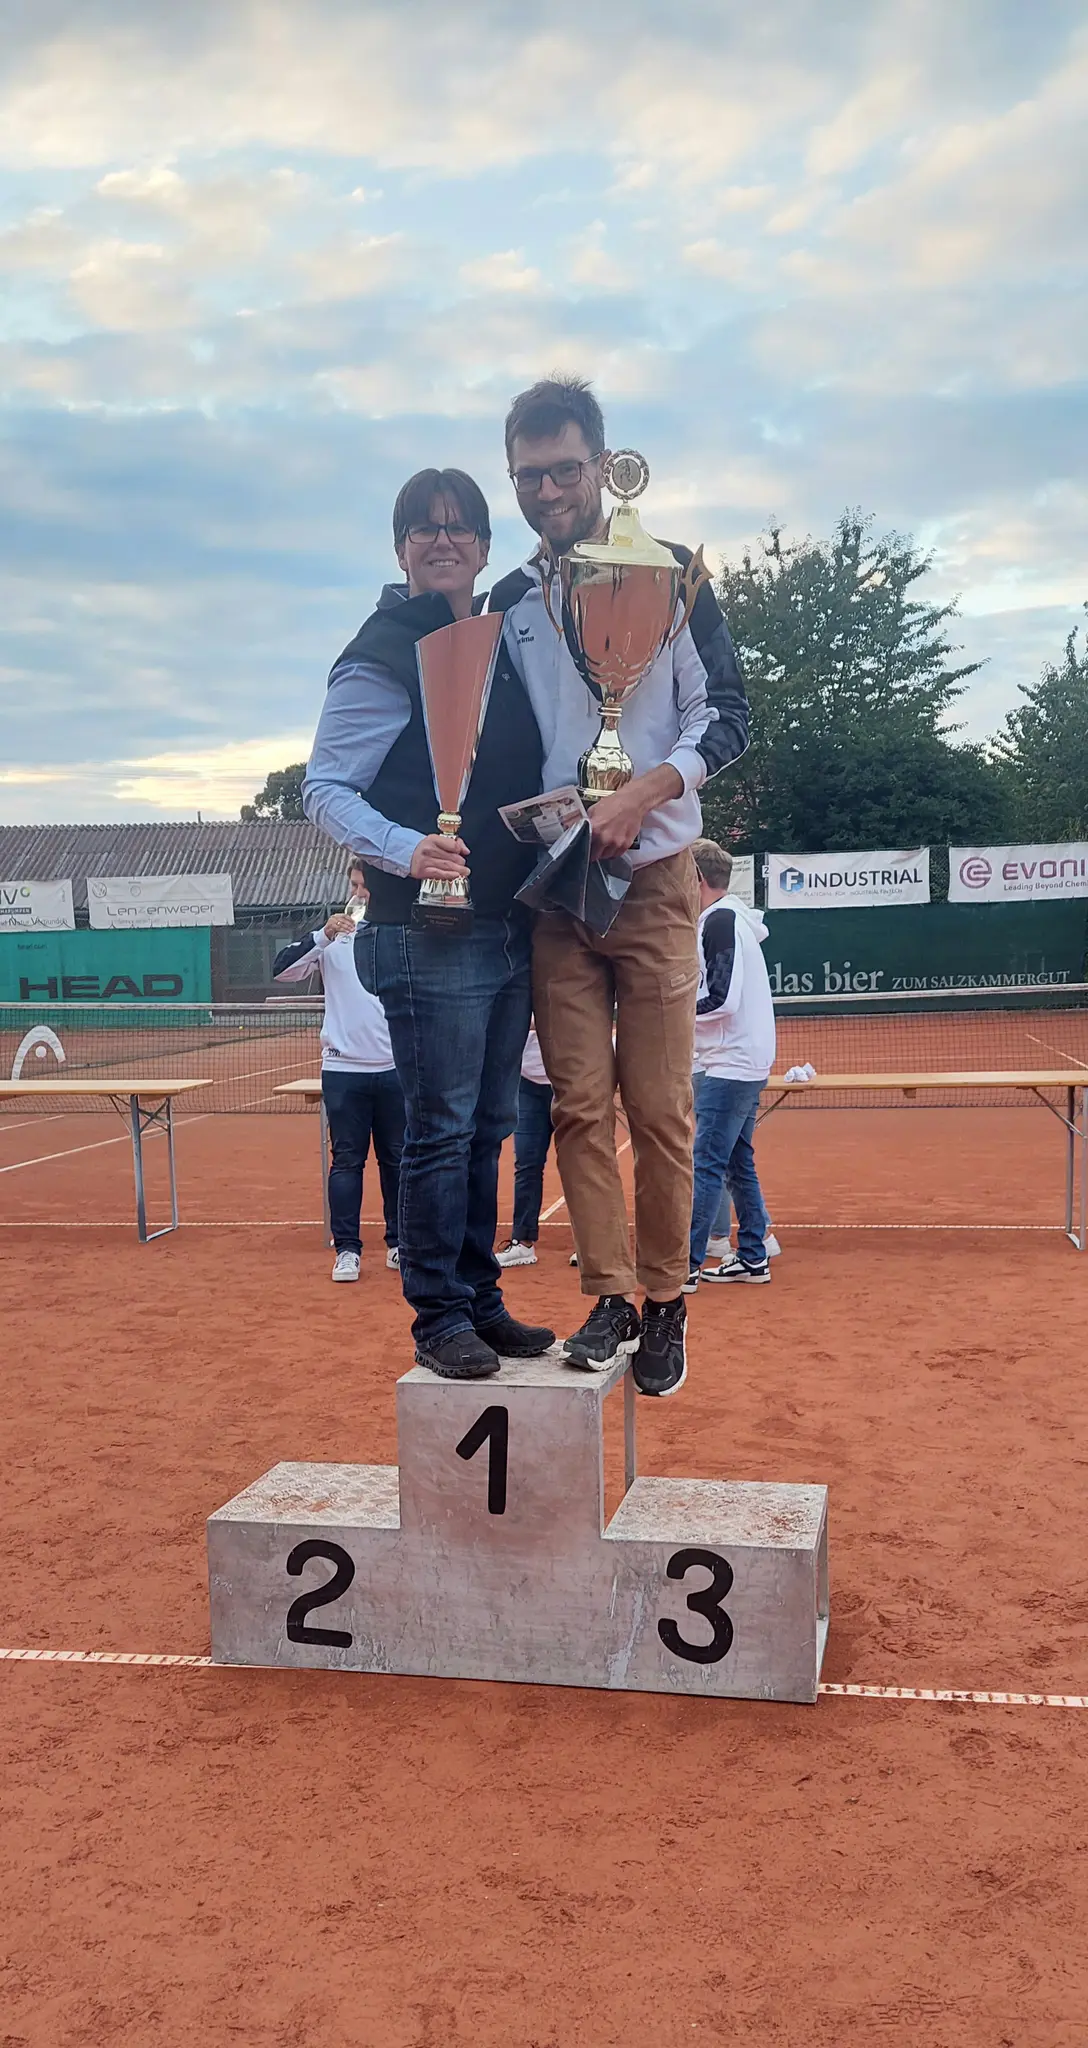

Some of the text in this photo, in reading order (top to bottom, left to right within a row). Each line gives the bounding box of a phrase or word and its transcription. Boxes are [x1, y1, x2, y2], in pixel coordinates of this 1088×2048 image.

[808, 868, 923, 888] INDUSTRIAL
[1004, 884, 1034, 892] Leading
[1035, 882, 1064, 891] Beyond
[107, 904, 215, 916] Lenzenweger
[19, 974, 183, 999] HEAD
[768, 961, 1071, 993] das bier ZUM SALZKAMMERGUT
[455, 1406, 509, 1515] 1
[286, 1539, 356, 1648] 2
[657, 1548, 735, 1665] 3
